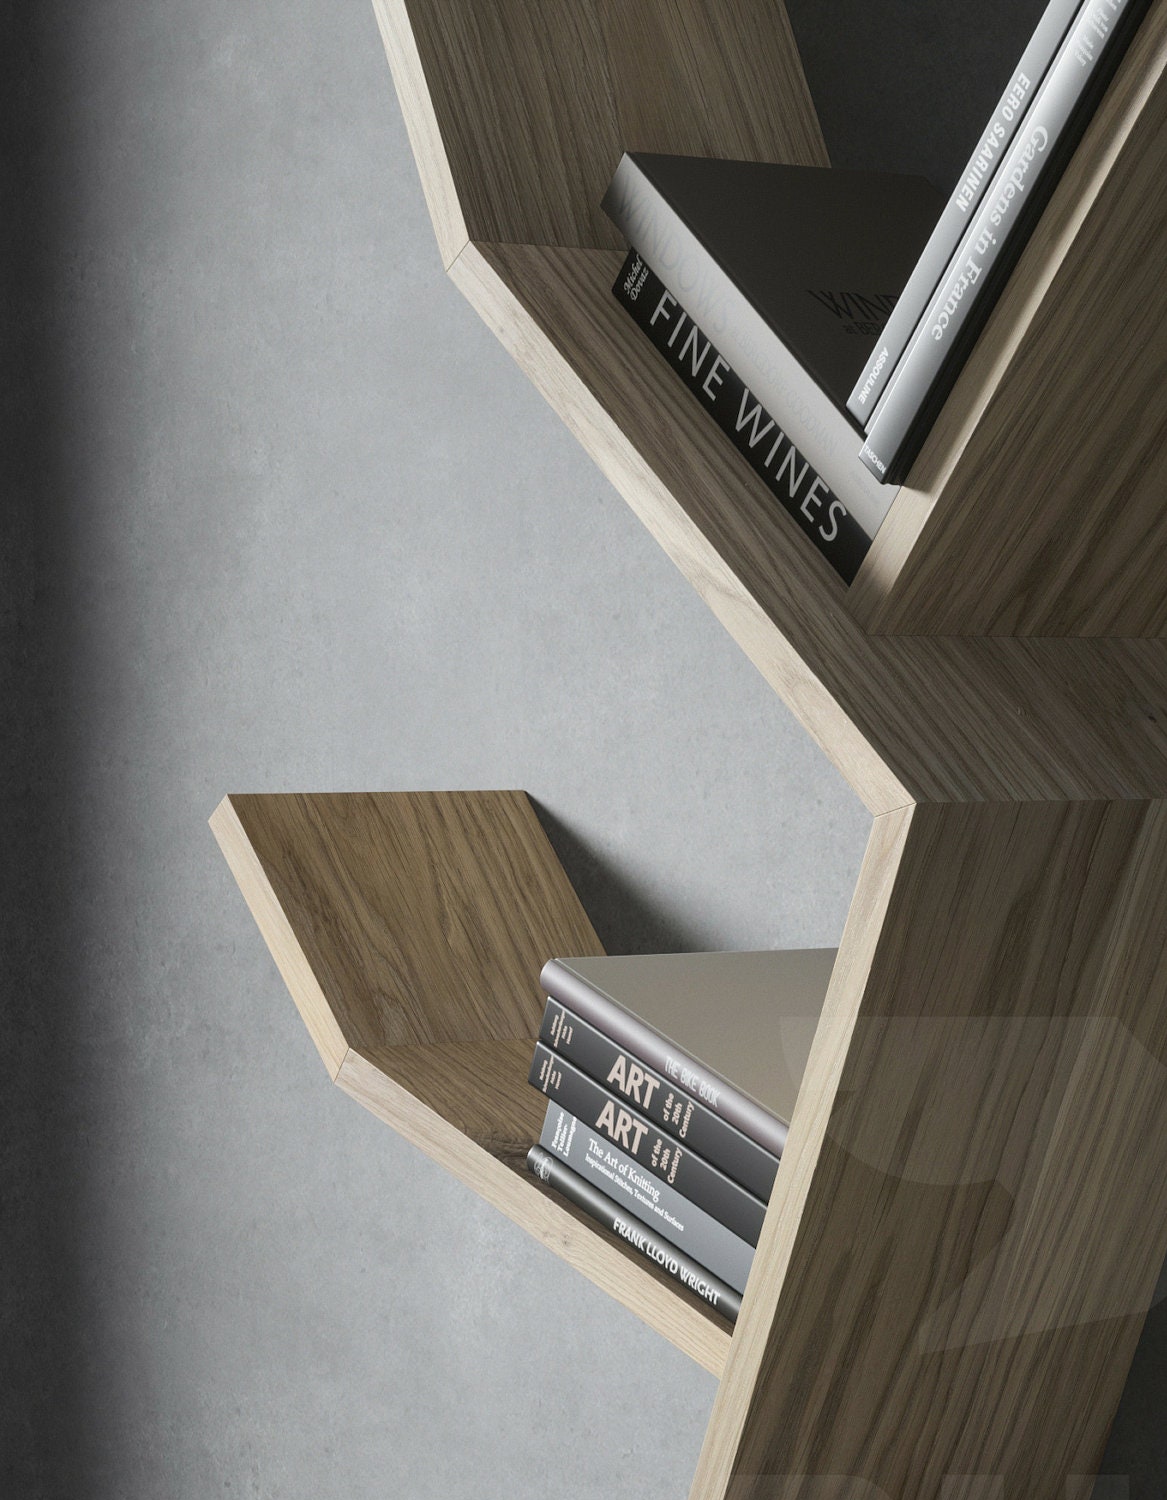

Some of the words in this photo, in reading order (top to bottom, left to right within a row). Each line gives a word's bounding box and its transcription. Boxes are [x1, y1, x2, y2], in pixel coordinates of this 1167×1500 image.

[1003, 72, 1031, 122] EERO
[955, 121, 1006, 213] SAARINEN
[989, 125, 1049, 228] Gardens
[973, 222, 998, 258] in
[931, 257, 983, 342] France
[858, 346, 889, 405] ASSOULINE
[649, 289, 731, 402] FINE
[734, 386, 848, 543] WINES
[862, 443, 886, 476] TASCHEN
[606, 1054, 661, 1110] ART
[664, 1055, 681, 1080] THE
[698, 1080, 721, 1108] BOOK
[594, 1099, 649, 1156] ART
[671, 1102, 683, 1126] 20th
[679, 1101, 695, 1139] Century
[588, 1138, 604, 1160] The
[604, 1152, 620, 1172] Art
[627, 1168, 661, 1203] Knitting
[659, 1148, 671, 1171] 20th
[667, 1146, 683, 1184] Century
[613, 1217, 645, 1251] FRANK
[646, 1241, 678, 1275] LLOYD
[679, 1266, 721, 1305] WRIGHT
